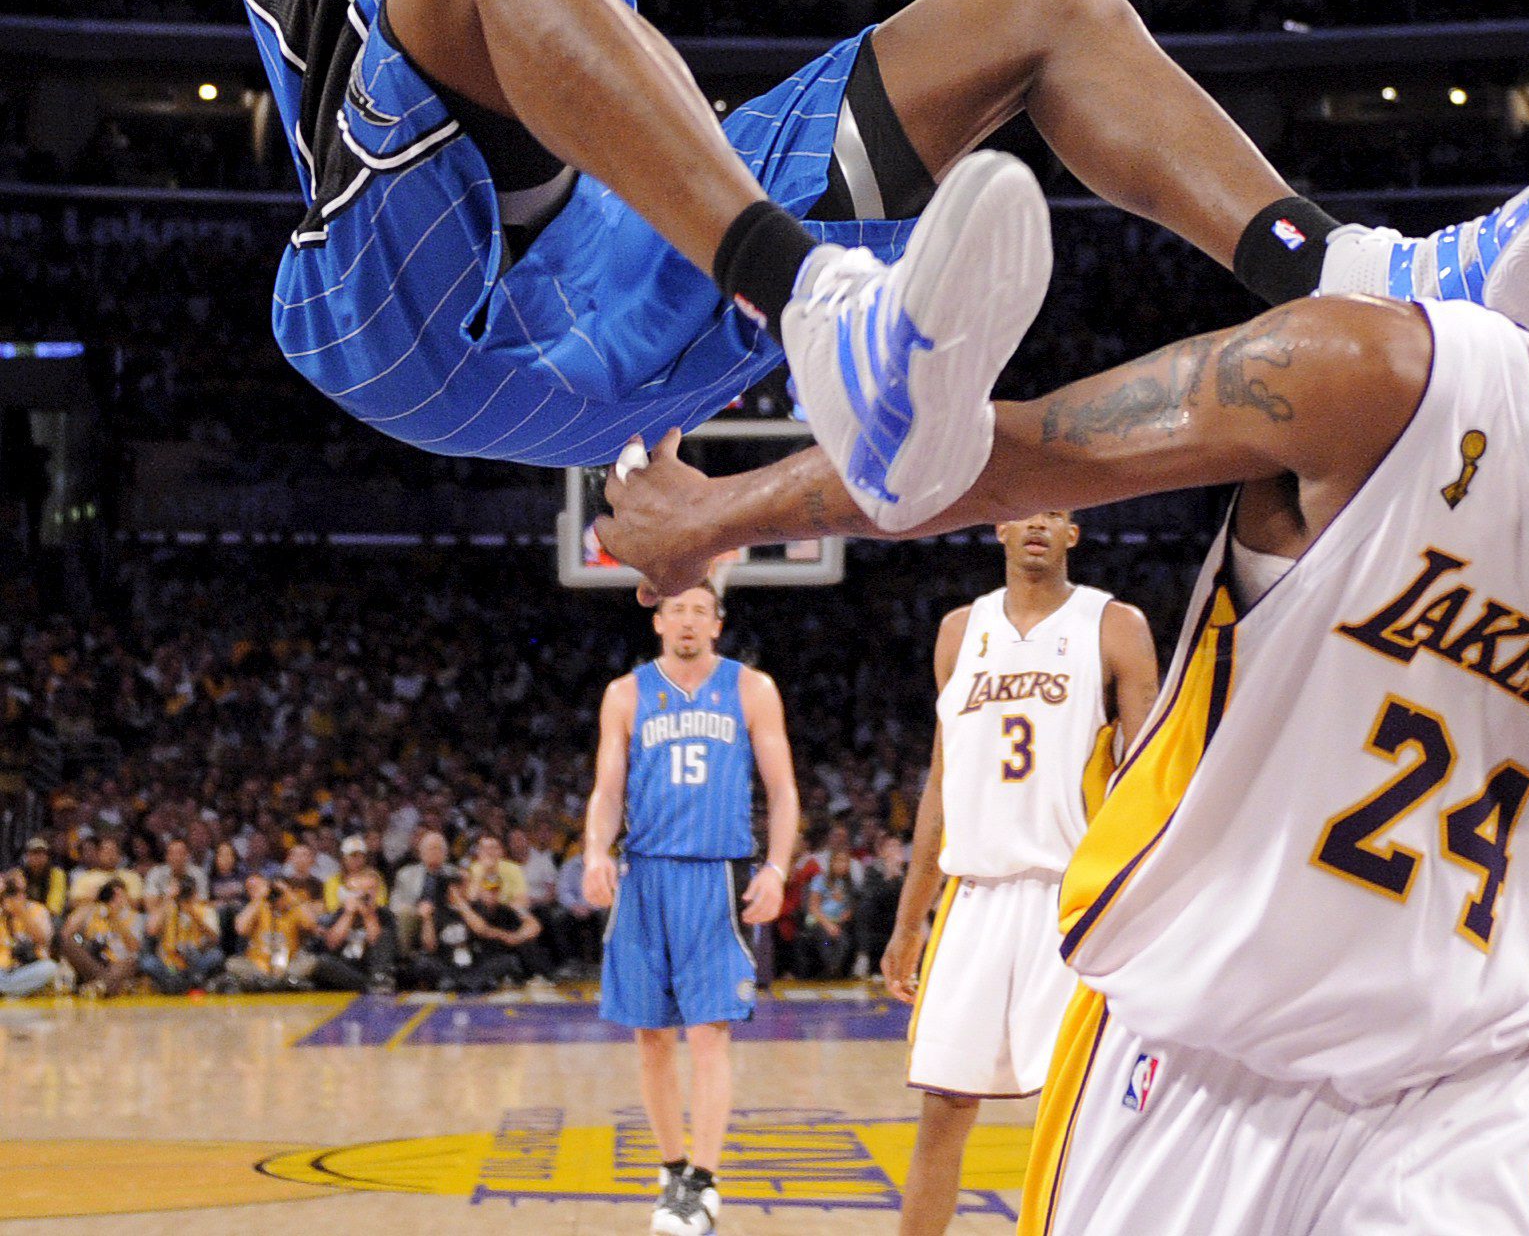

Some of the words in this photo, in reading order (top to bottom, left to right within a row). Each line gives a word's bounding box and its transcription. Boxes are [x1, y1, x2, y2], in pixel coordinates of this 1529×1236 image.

[958, 671, 1071, 717] LAKERS
[641, 710, 737, 750] ORLANDO
[1001, 714, 1036, 784] 3
[669, 743, 709, 786] 15
